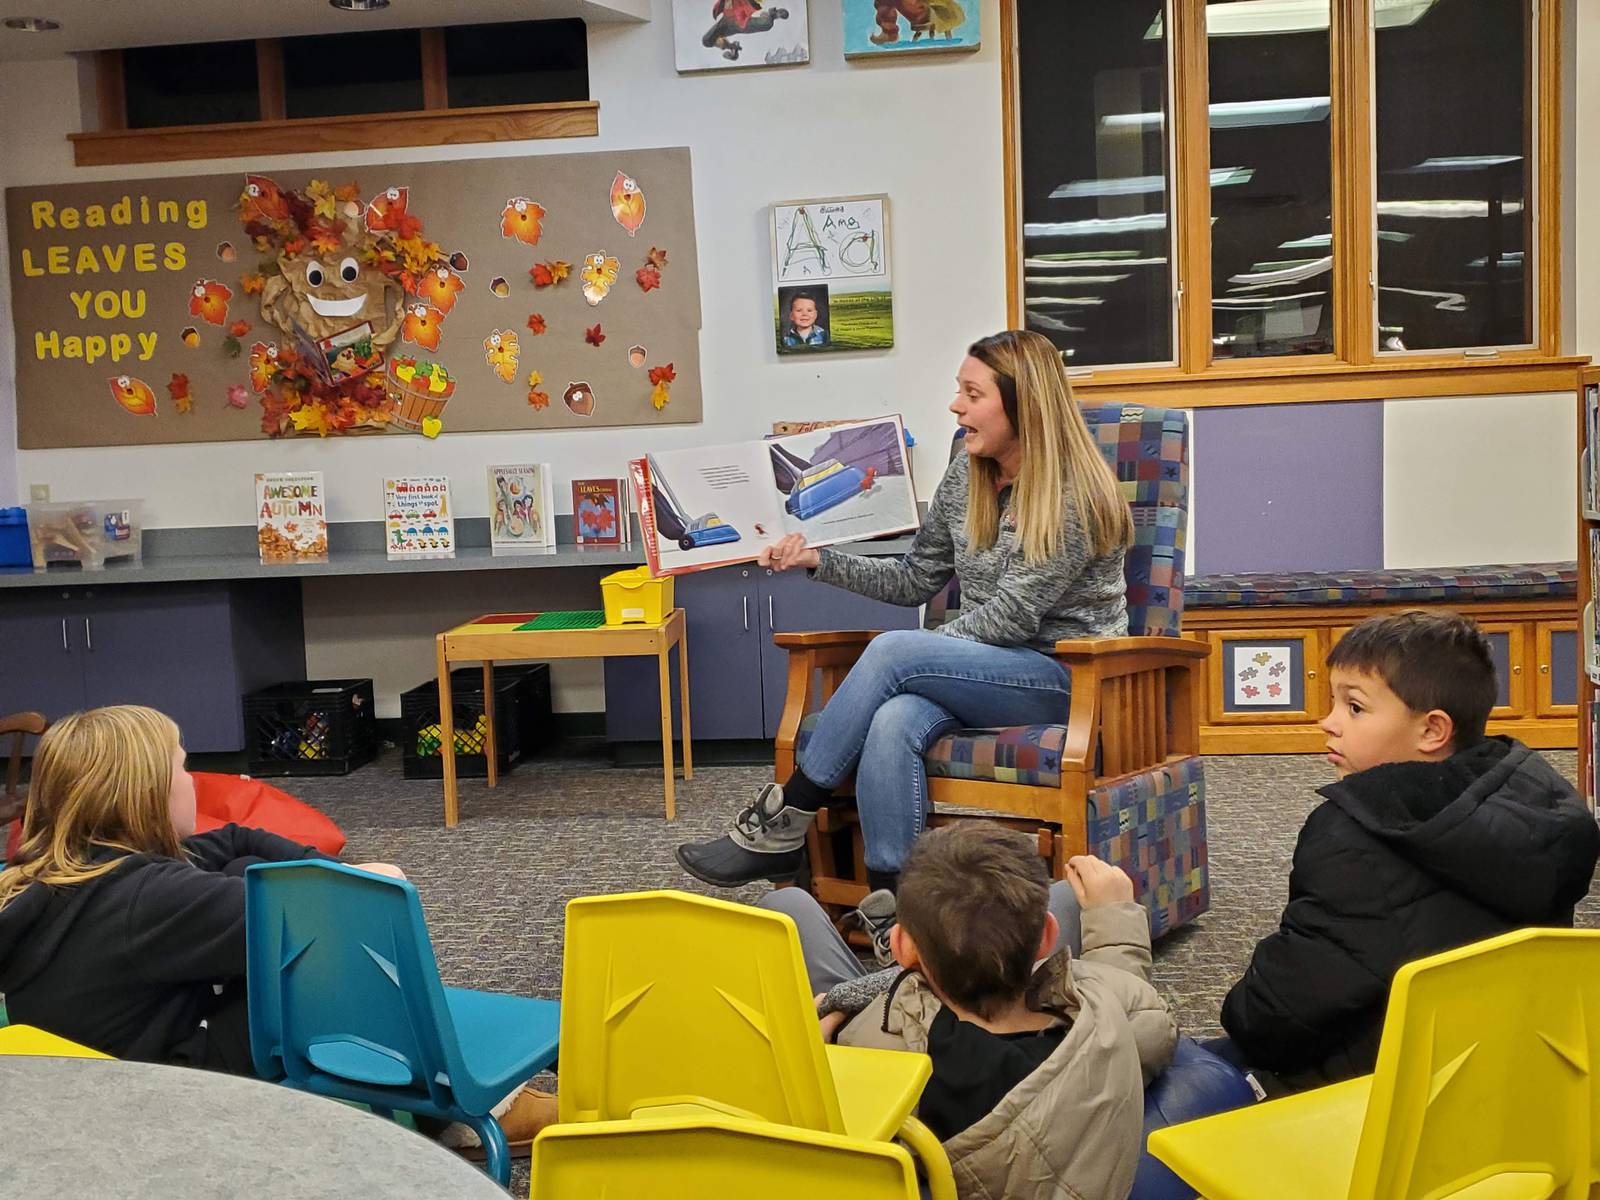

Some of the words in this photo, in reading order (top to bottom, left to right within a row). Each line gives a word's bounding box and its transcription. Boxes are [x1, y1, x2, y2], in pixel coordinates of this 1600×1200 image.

[31, 195, 208, 229] Reading
[22, 242, 187, 277] LEAVES
[70, 289, 146, 319] YOU
[35, 330, 158, 364] Happy
[263, 484, 318, 500] AWESOME
[260, 500, 323, 518] AUTUMN
